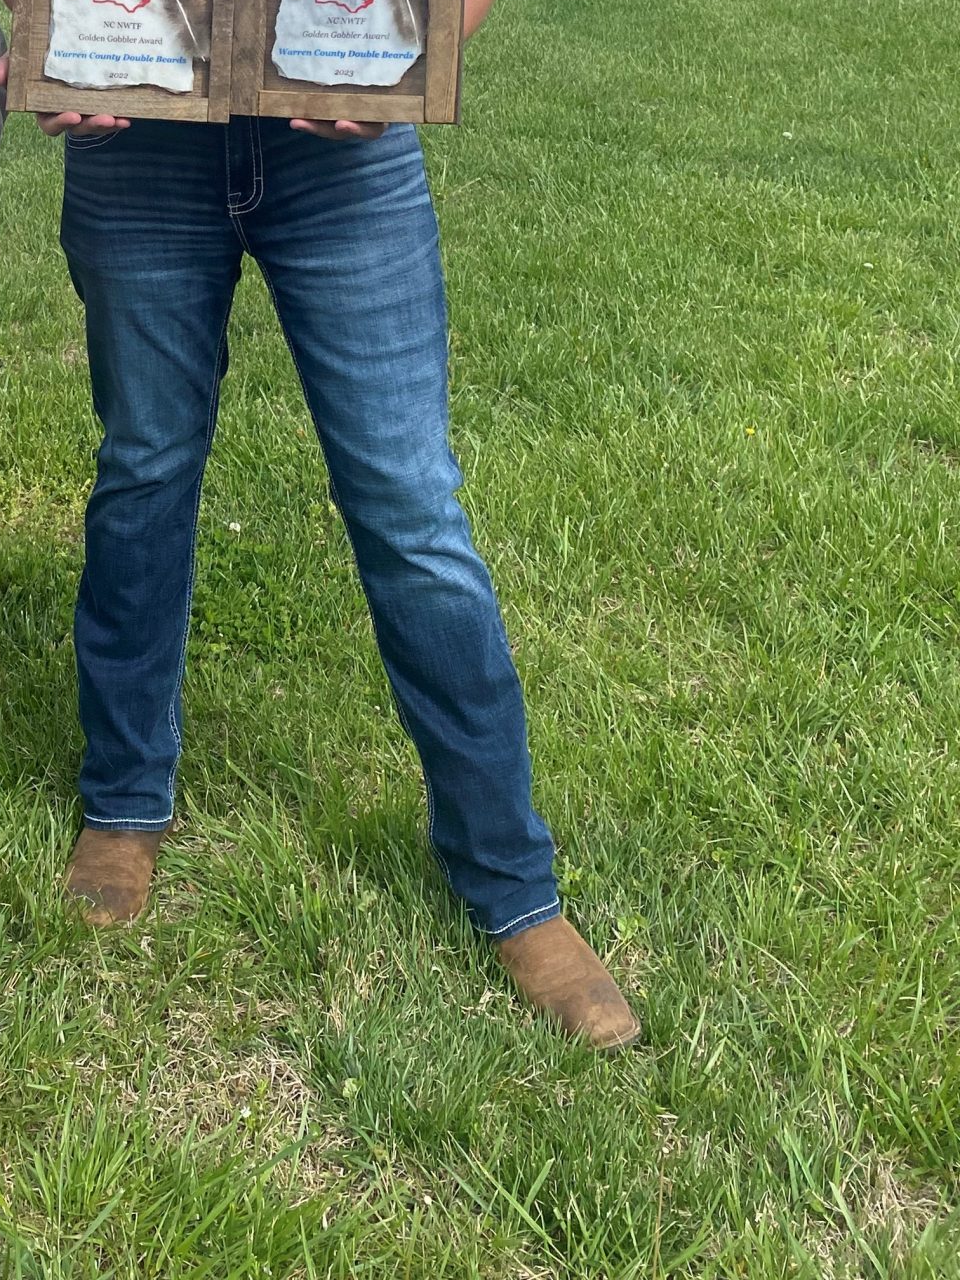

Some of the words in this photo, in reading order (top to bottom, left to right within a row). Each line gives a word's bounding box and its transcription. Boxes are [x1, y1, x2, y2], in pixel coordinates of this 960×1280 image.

[103, 20, 116, 29] NC
[116, 21, 142, 30] NWTF
[326, 16, 340, 25] NC
[340, 17, 367, 25] NWTF
[78, 33, 105, 42] Golden
[107, 34, 138, 44] Gobbler
[138, 37, 163, 45] Award
[302, 30, 329, 39] Golden
[330, 31, 361, 40] Gobbler
[362, 32, 390, 40] Award
[53, 50, 87, 59] Warren
[89, 52, 121, 63] County
[123, 53, 154, 63] Double
[155, 54, 187, 64] Beards
[278, 48, 312, 57] Warren
[314, 48, 346, 59] County
[348, 49, 380, 59] Double
[381, 50, 414, 60] Beards
[334, 69, 354, 77] 2023
